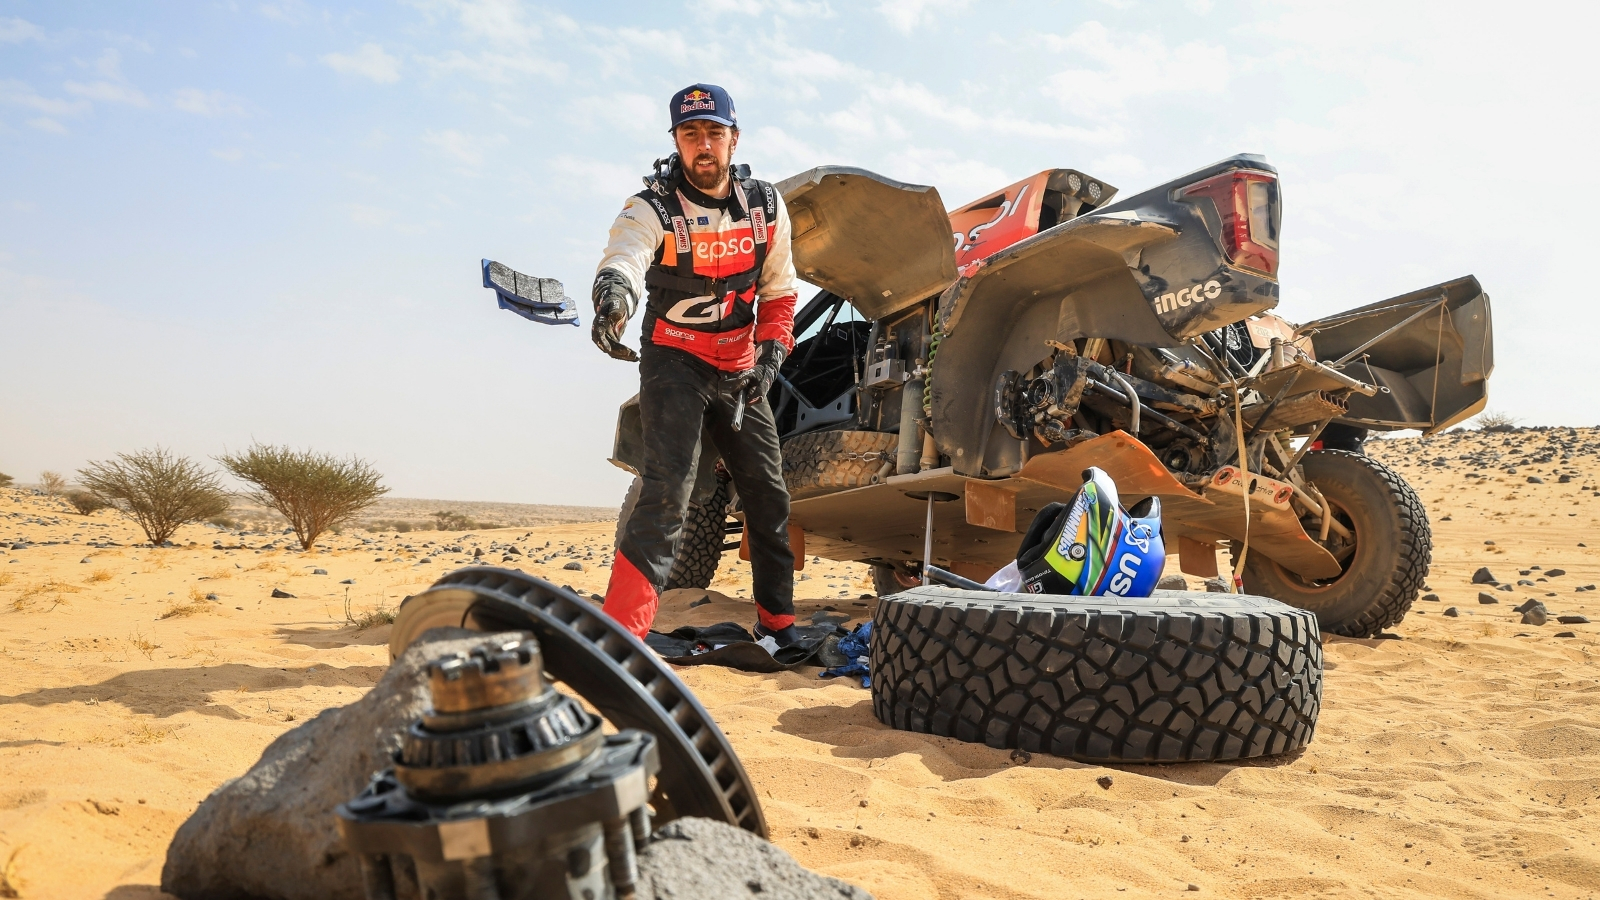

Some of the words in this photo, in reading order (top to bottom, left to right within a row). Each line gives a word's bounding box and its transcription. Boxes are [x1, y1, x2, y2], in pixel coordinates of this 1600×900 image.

[681, 102, 697, 113] Red
[697, 100, 715, 111] Bull
[651, 198, 671, 225] sparco
[764, 186, 775, 214] sparco
[675, 220, 687, 248] SIMPSON
[755, 211, 764, 239] SIMPSON
[665, 327, 695, 341] sparco
